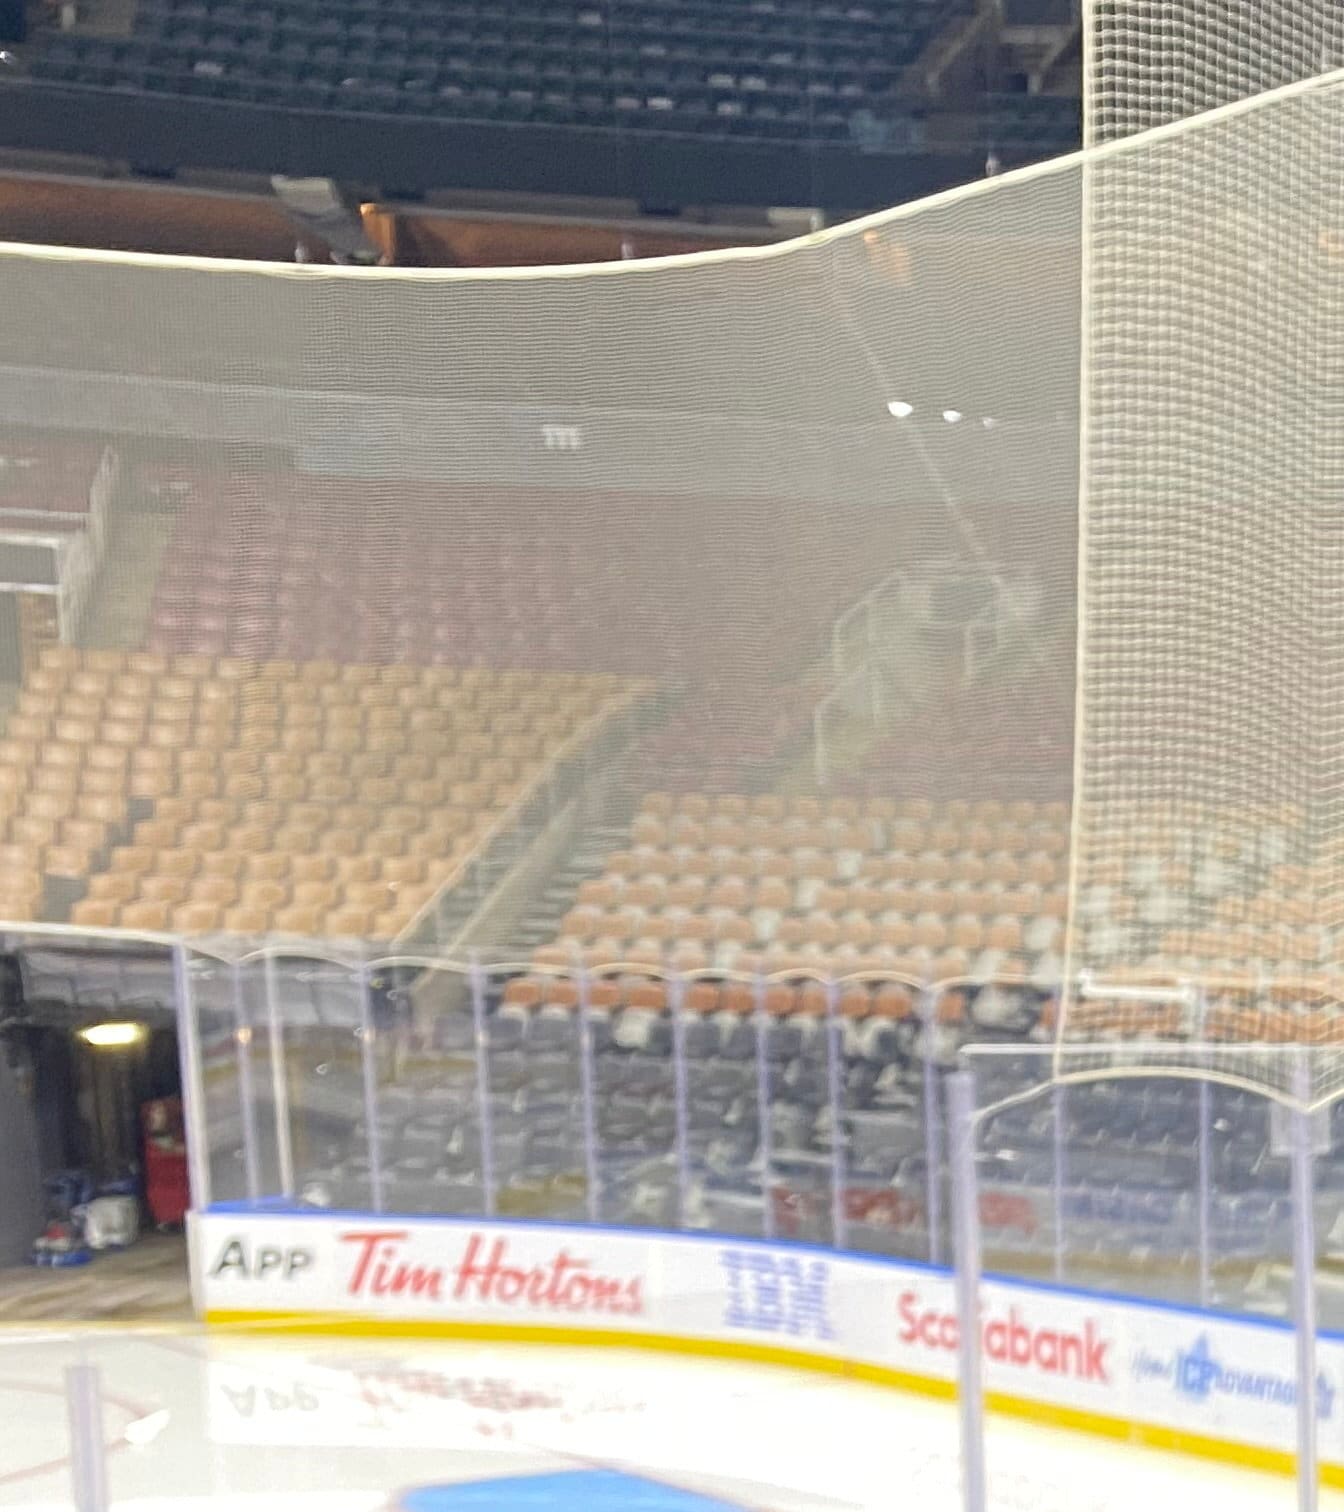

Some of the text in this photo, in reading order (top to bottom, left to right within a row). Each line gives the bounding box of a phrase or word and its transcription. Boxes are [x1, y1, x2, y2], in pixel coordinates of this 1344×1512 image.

[339, 1230, 647, 1314] Tim Hortons
[897, 1291, 1113, 1384] Scoabank
